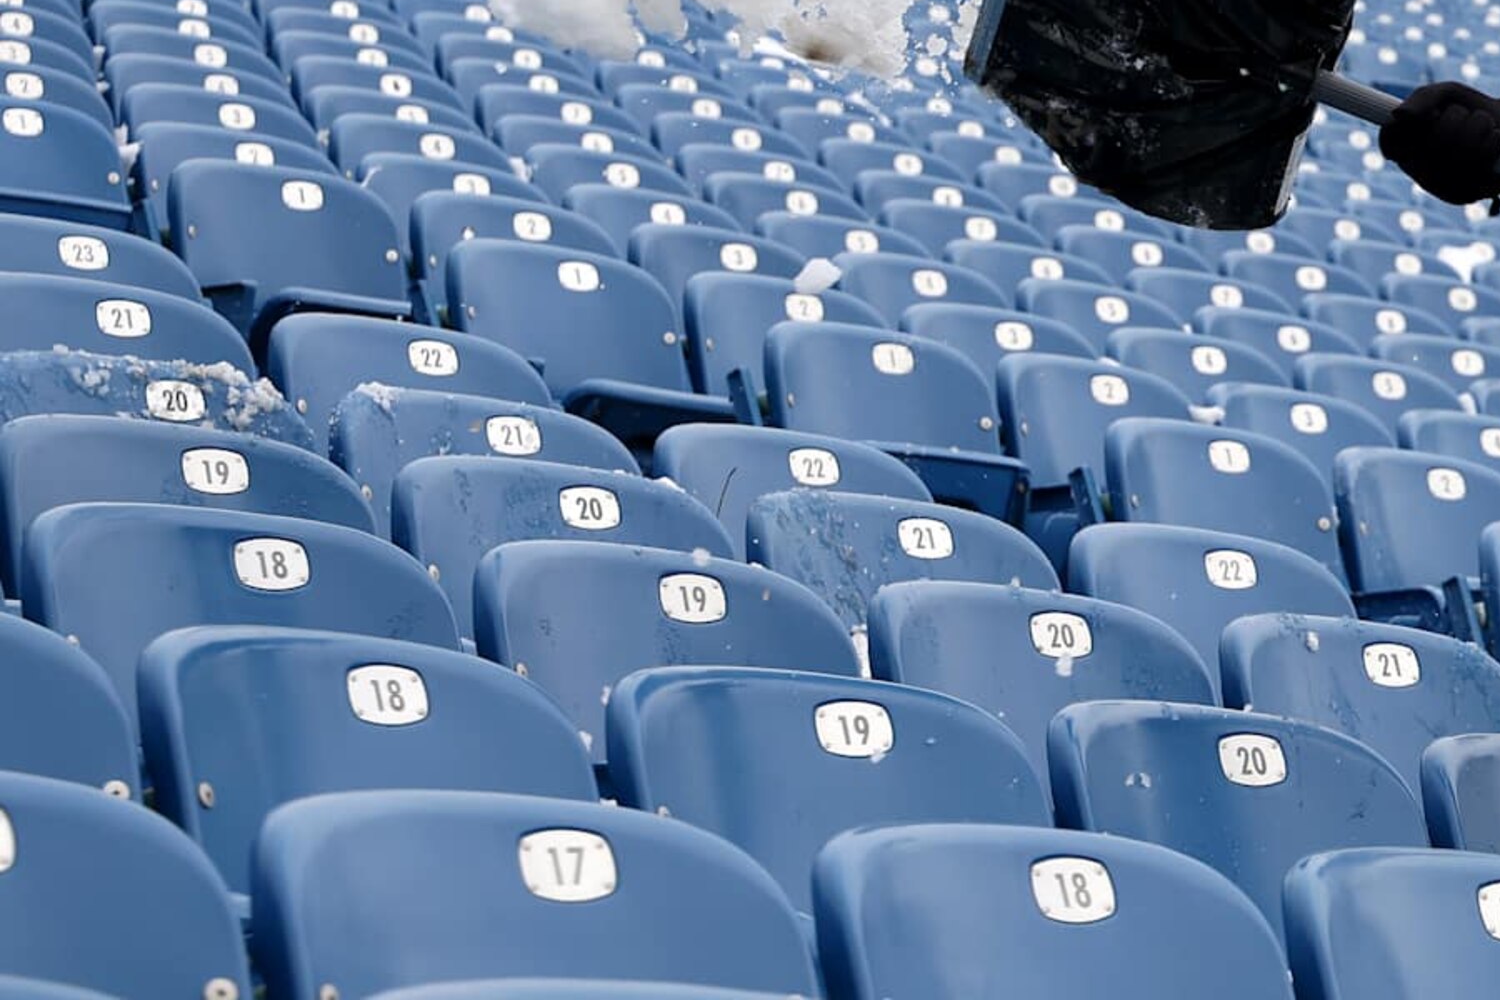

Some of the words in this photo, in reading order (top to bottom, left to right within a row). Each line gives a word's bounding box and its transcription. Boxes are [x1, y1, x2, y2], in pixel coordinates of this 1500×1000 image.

[72, 244, 94, 262] 23
[111, 309, 134, 328] 21
[420, 348, 443, 367] 22
[161, 390, 188, 413] 20
[504, 425, 524, 445] 21
[201, 460, 229, 485] 19
[802, 458, 825, 478] 22
[576, 497, 603, 521] 20
[912, 527, 935, 549] 21
[255, 551, 288, 579] 18
[1218, 560, 1242, 580] 22
[679, 586, 706, 612] 19
[1048, 623, 1075, 648] 20
[1378, 653, 1402, 677] 21
[370, 679, 405, 712] 18
[838, 715, 869, 746] 19
[1237, 746, 1267, 776] 20
[547, 846, 585, 886] 17
[1054, 872, 1092, 909] 18
